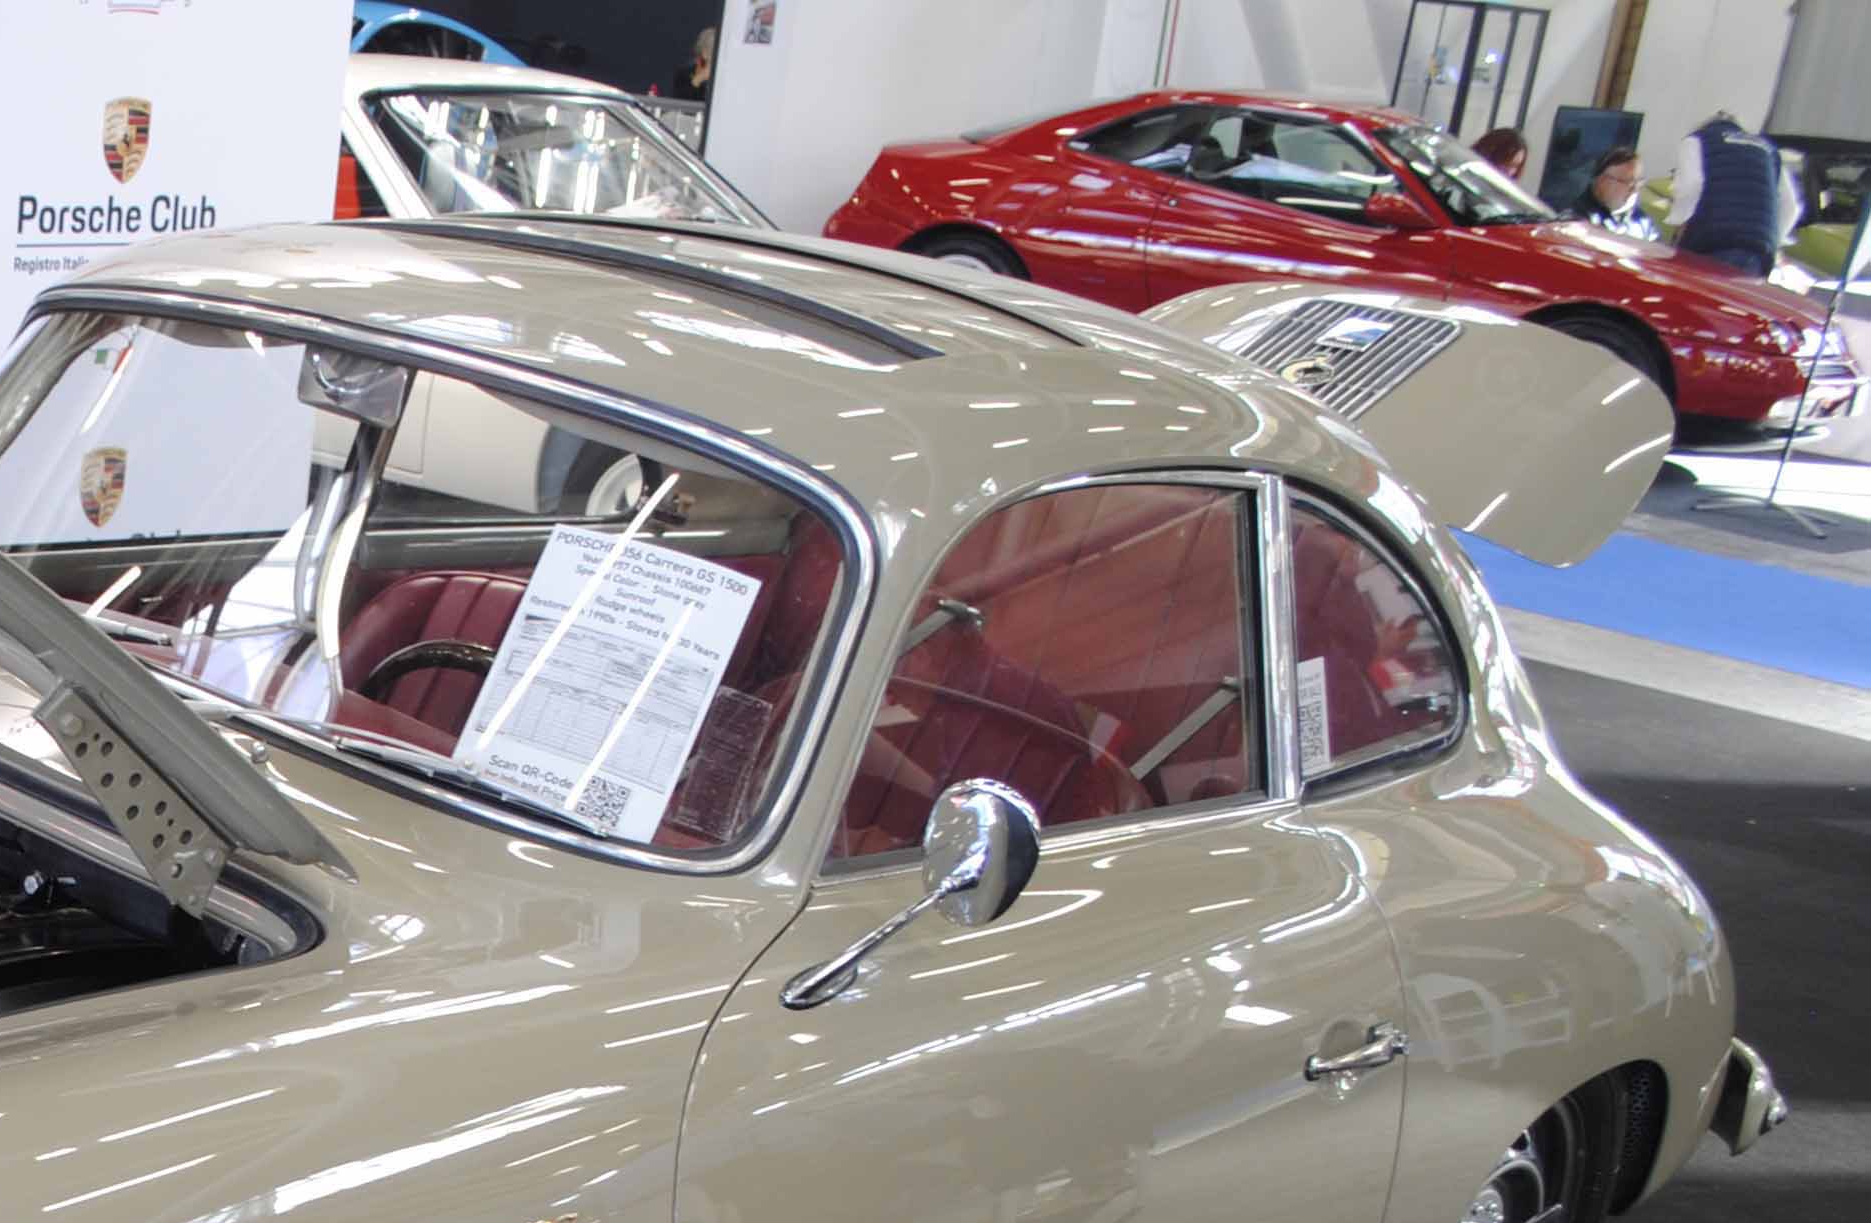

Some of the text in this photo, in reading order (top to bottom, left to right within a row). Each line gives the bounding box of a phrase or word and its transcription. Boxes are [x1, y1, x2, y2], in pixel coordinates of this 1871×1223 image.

[17, 195, 216, 234] Porsche Club
[14, 256, 61, 275] Registro
[646, 552, 694, 576] Carrera
[697, 568, 716, 583] GS
